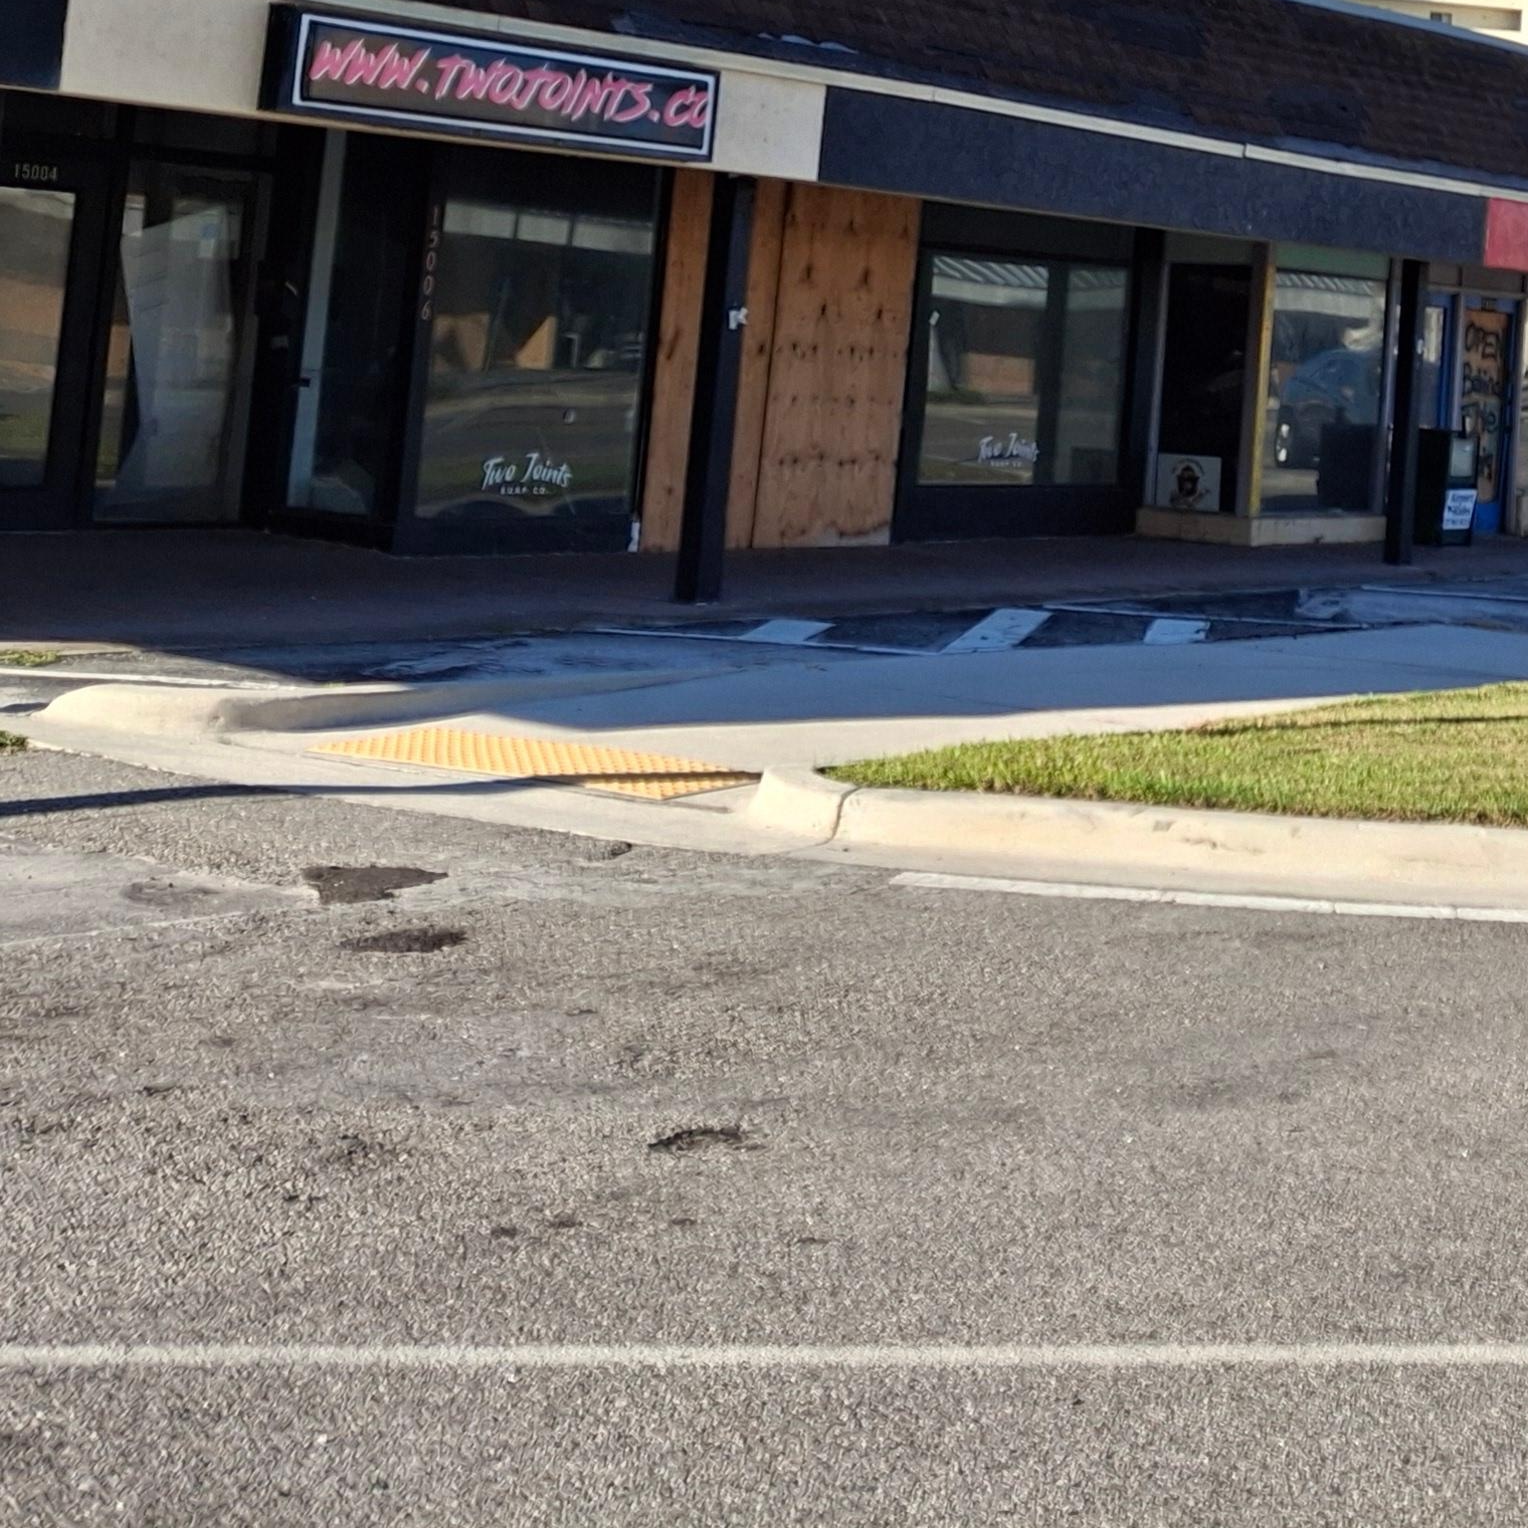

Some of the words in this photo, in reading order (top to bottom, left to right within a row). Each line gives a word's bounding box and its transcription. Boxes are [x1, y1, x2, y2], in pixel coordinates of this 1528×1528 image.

[14, 163, 58, 182] 15004
[421, 205, 439, 320] 15006
[482, 456, 516, 490] Two
[521, 452, 572, 488] Joints
